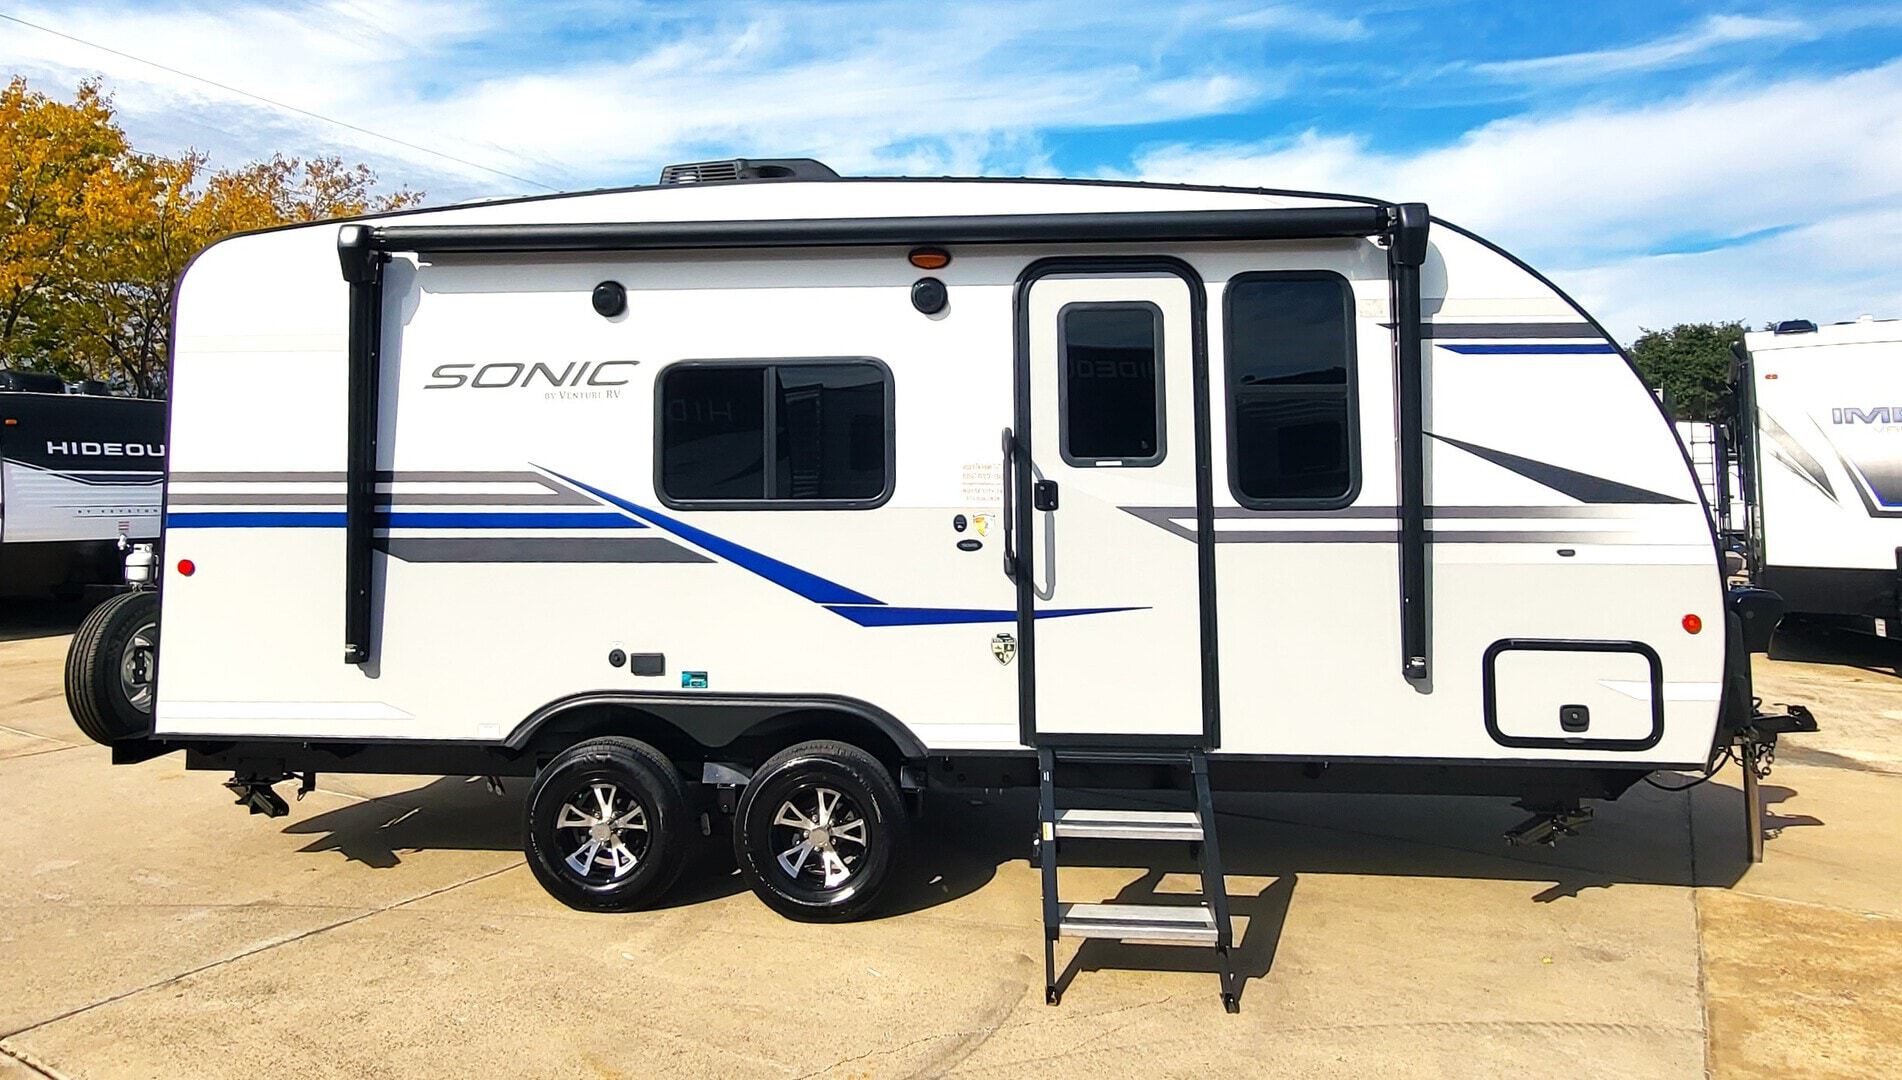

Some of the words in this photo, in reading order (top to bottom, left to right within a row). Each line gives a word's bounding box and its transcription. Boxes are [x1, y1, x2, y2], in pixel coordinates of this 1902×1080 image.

[423, 360, 640, 389] SONIC
[606, 389, 621, 400] RV
[46, 440, 165, 457] HIDEOU
